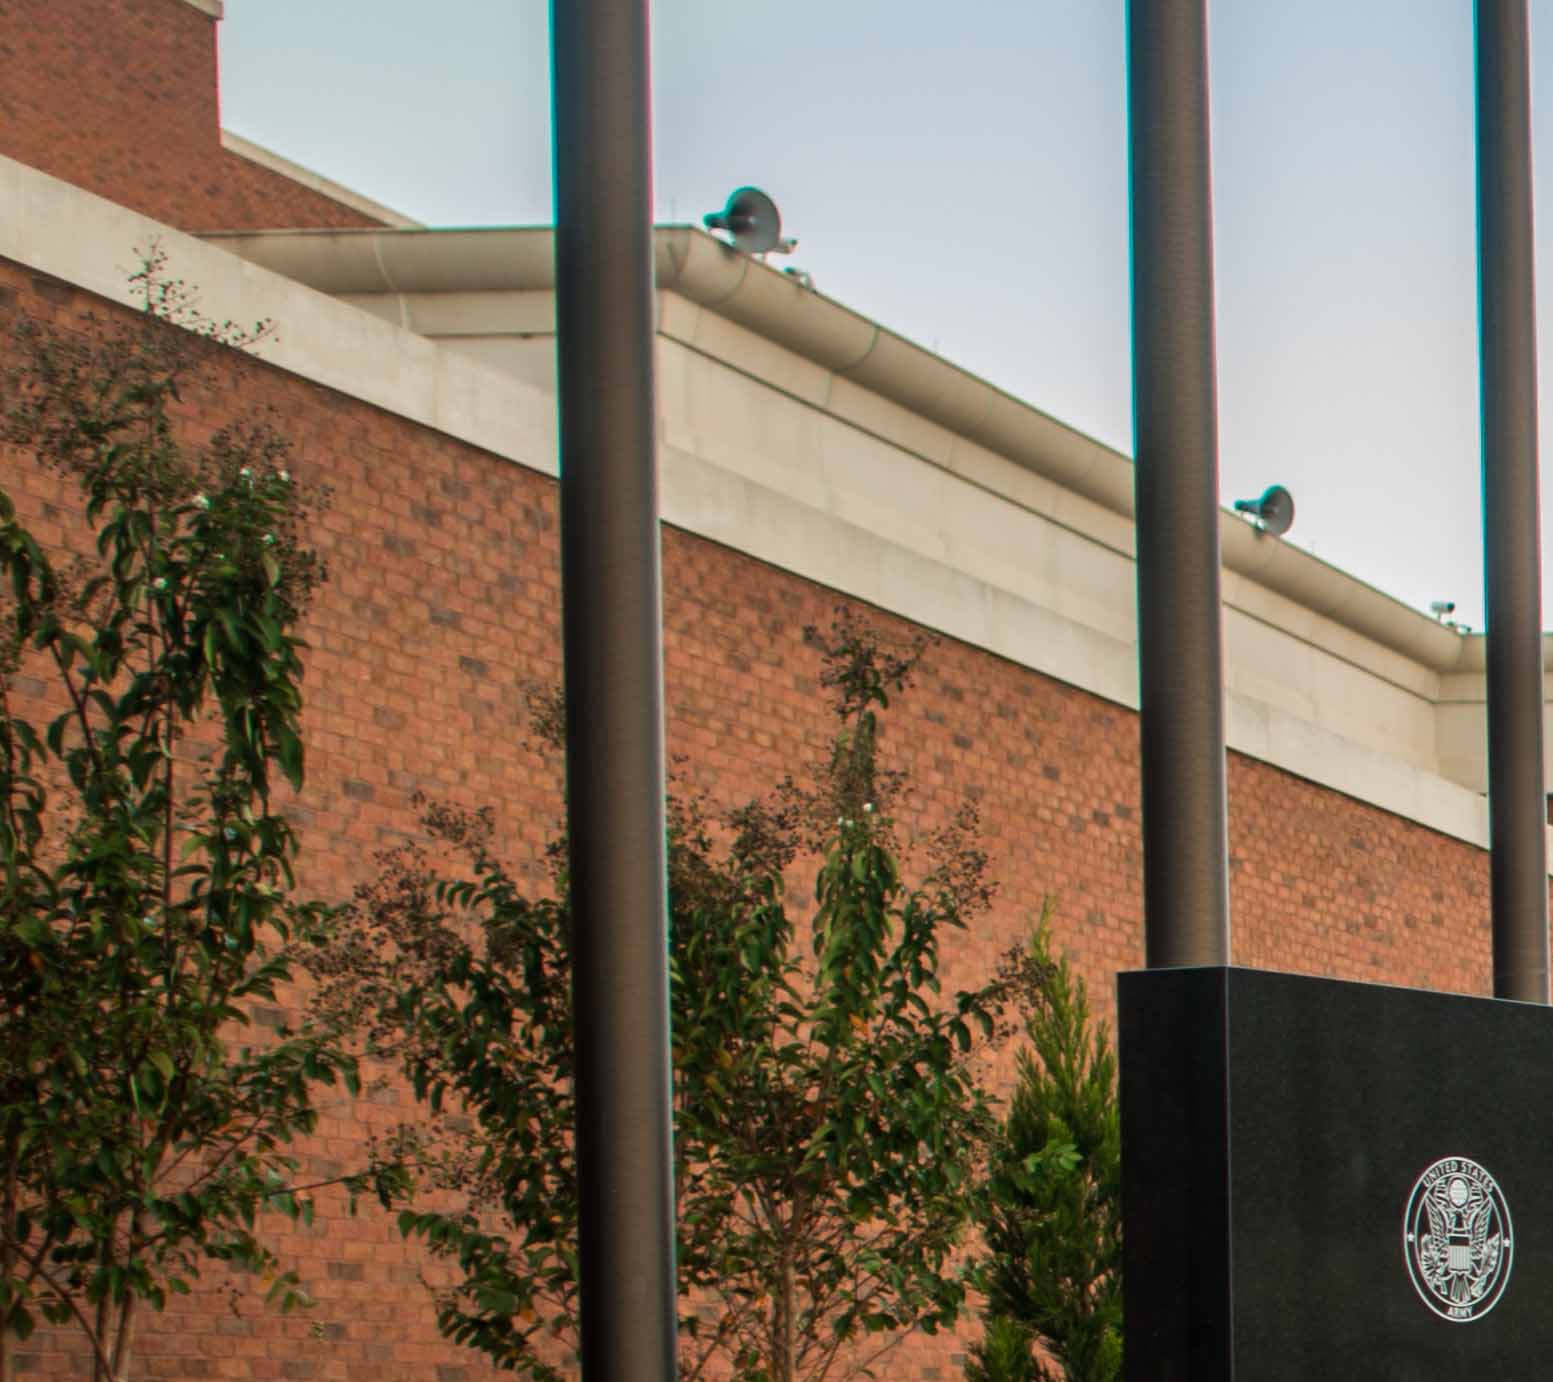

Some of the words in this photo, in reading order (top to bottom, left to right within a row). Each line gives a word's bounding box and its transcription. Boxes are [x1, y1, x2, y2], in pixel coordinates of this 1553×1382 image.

[1423, 1161, 1457, 1188] UNITED
[1461, 1161, 1494, 1192] STATES
[1447, 1306, 1474, 1318] ARMY
